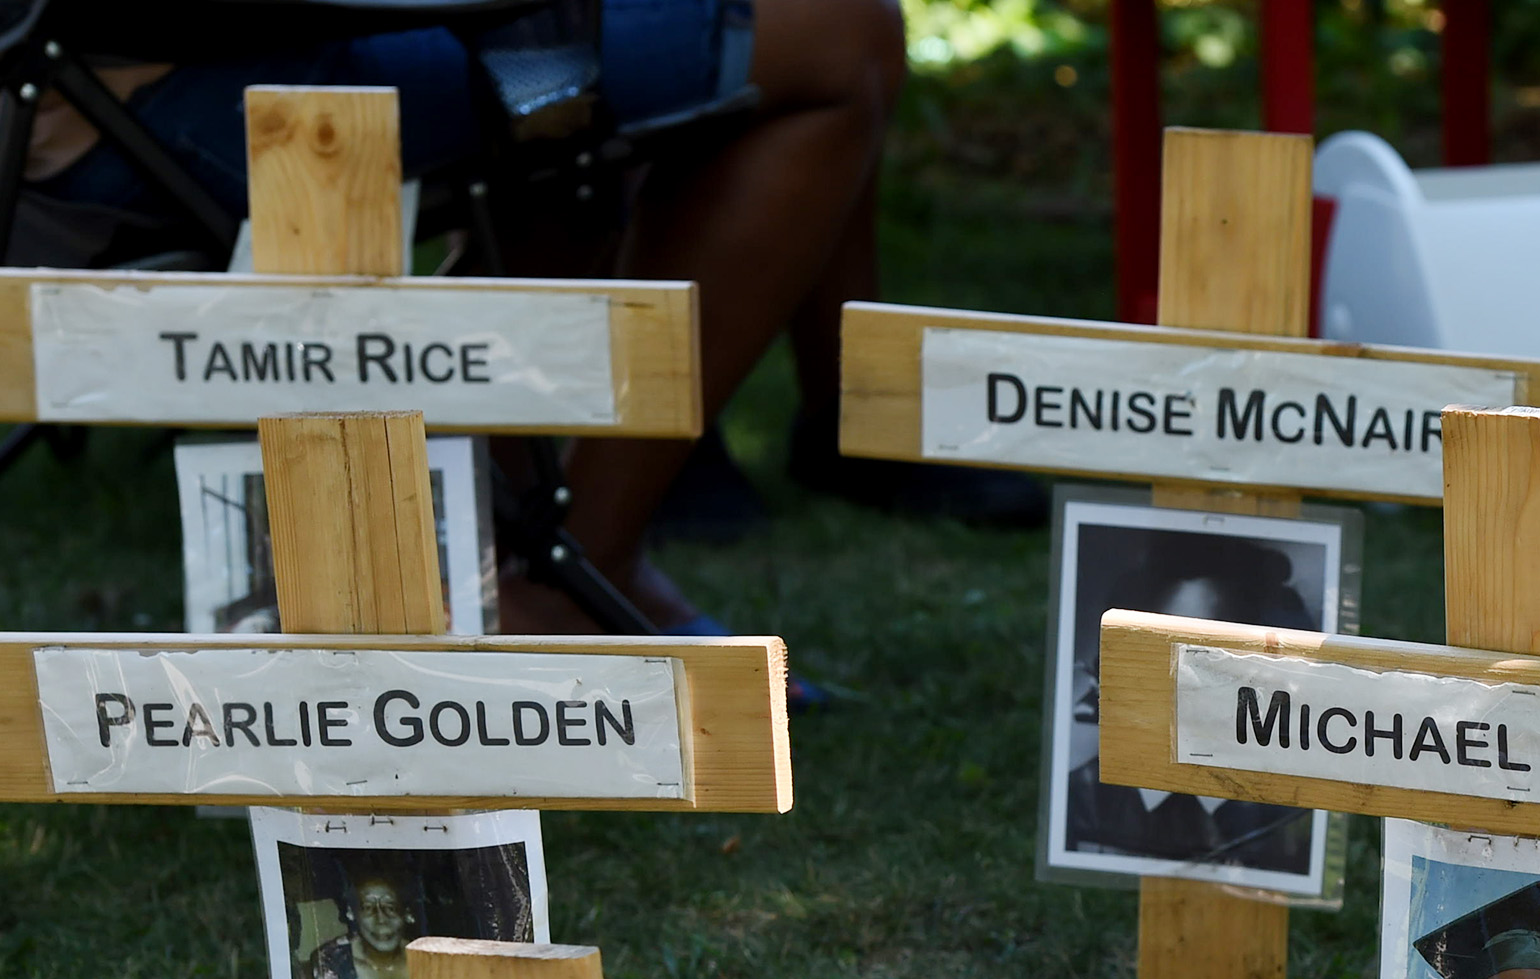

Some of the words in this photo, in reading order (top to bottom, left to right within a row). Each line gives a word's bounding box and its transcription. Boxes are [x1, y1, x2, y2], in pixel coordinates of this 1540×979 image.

[159, 331, 335, 384] TAMIR
[356, 332, 491, 385] RICE
[986, 372, 1194, 437] DENISE
[95, 692, 353, 749] PEARLIE
[372, 689, 637, 748] GOLDEN
[1235, 686, 1532, 773] MICHAEL
